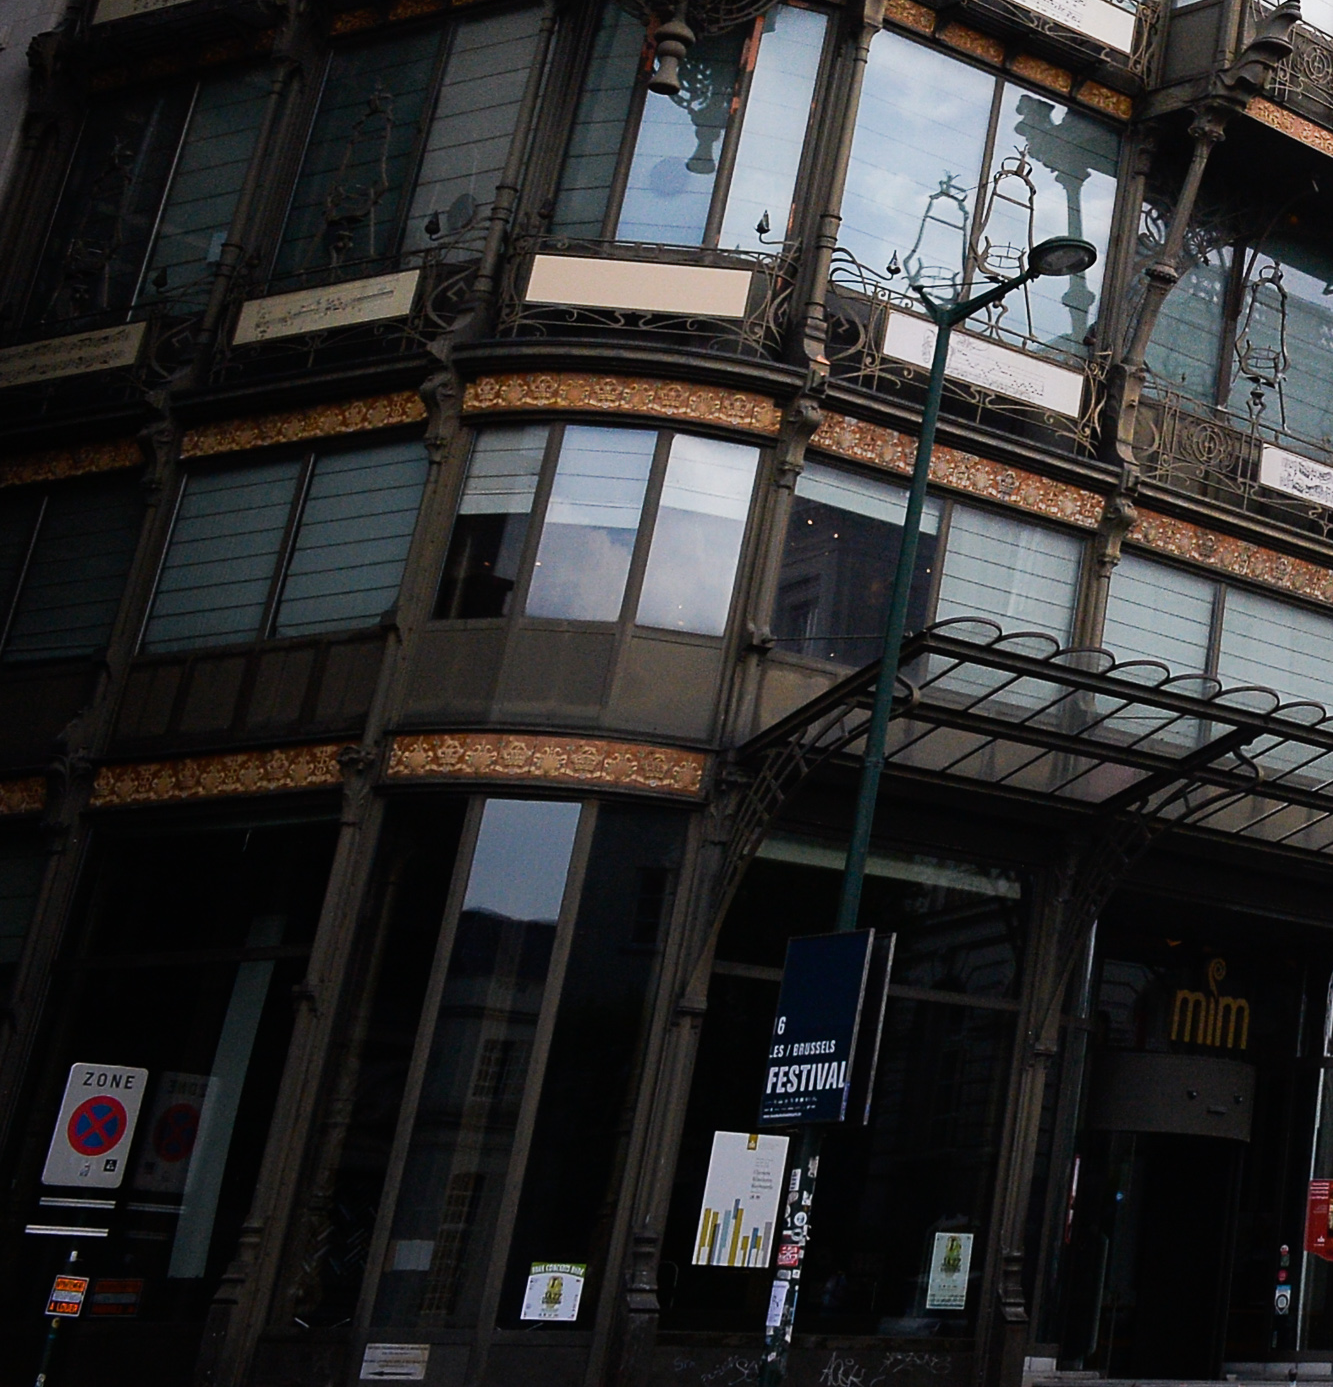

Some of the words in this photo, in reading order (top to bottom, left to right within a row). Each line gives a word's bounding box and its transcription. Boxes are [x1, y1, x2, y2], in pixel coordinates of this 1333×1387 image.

[1170, 957, 1250, 1050] mim
[792, 1039, 836, 1057] BRUSSELS
[83, 1072, 136, 1089] ZONE
[766, 1061, 847, 1094] FESTIVAL
